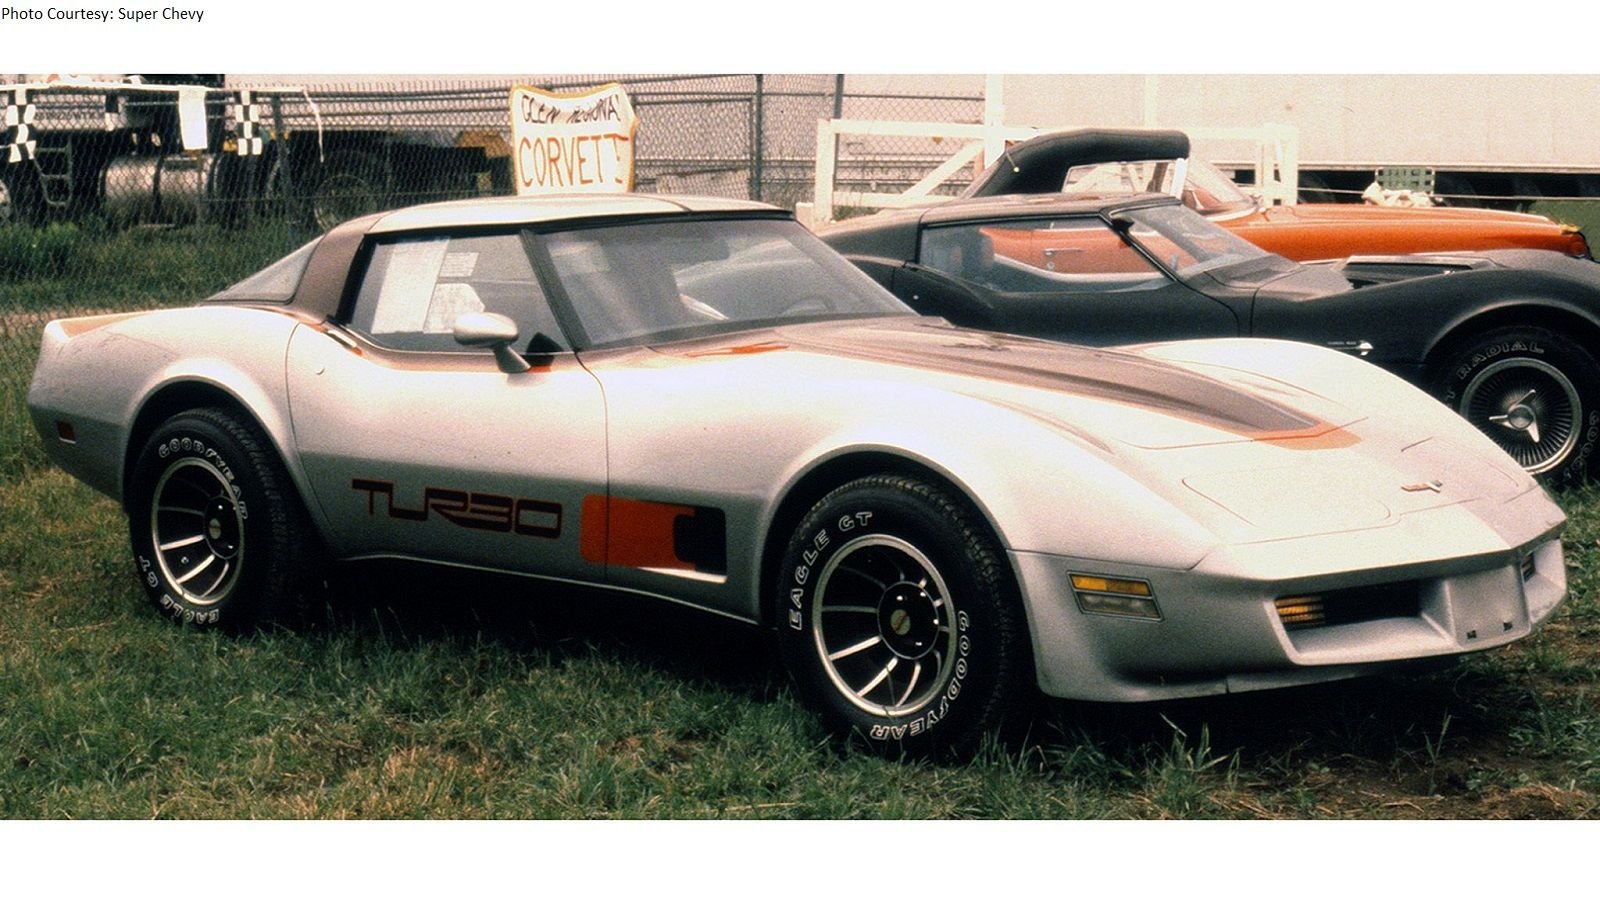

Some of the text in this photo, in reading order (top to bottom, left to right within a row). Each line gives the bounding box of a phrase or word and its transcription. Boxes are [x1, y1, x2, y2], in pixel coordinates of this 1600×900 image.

[1456, 340, 1545, 380] RADIAL
[158, 437, 249, 520] GOODYEAR
[351, 478, 564, 540] TURBO
[789, 511, 873, 631] EAGLE GT
[160, 593, 220, 625] EAGLE
[869, 610, 971, 741] GOODYEAR
